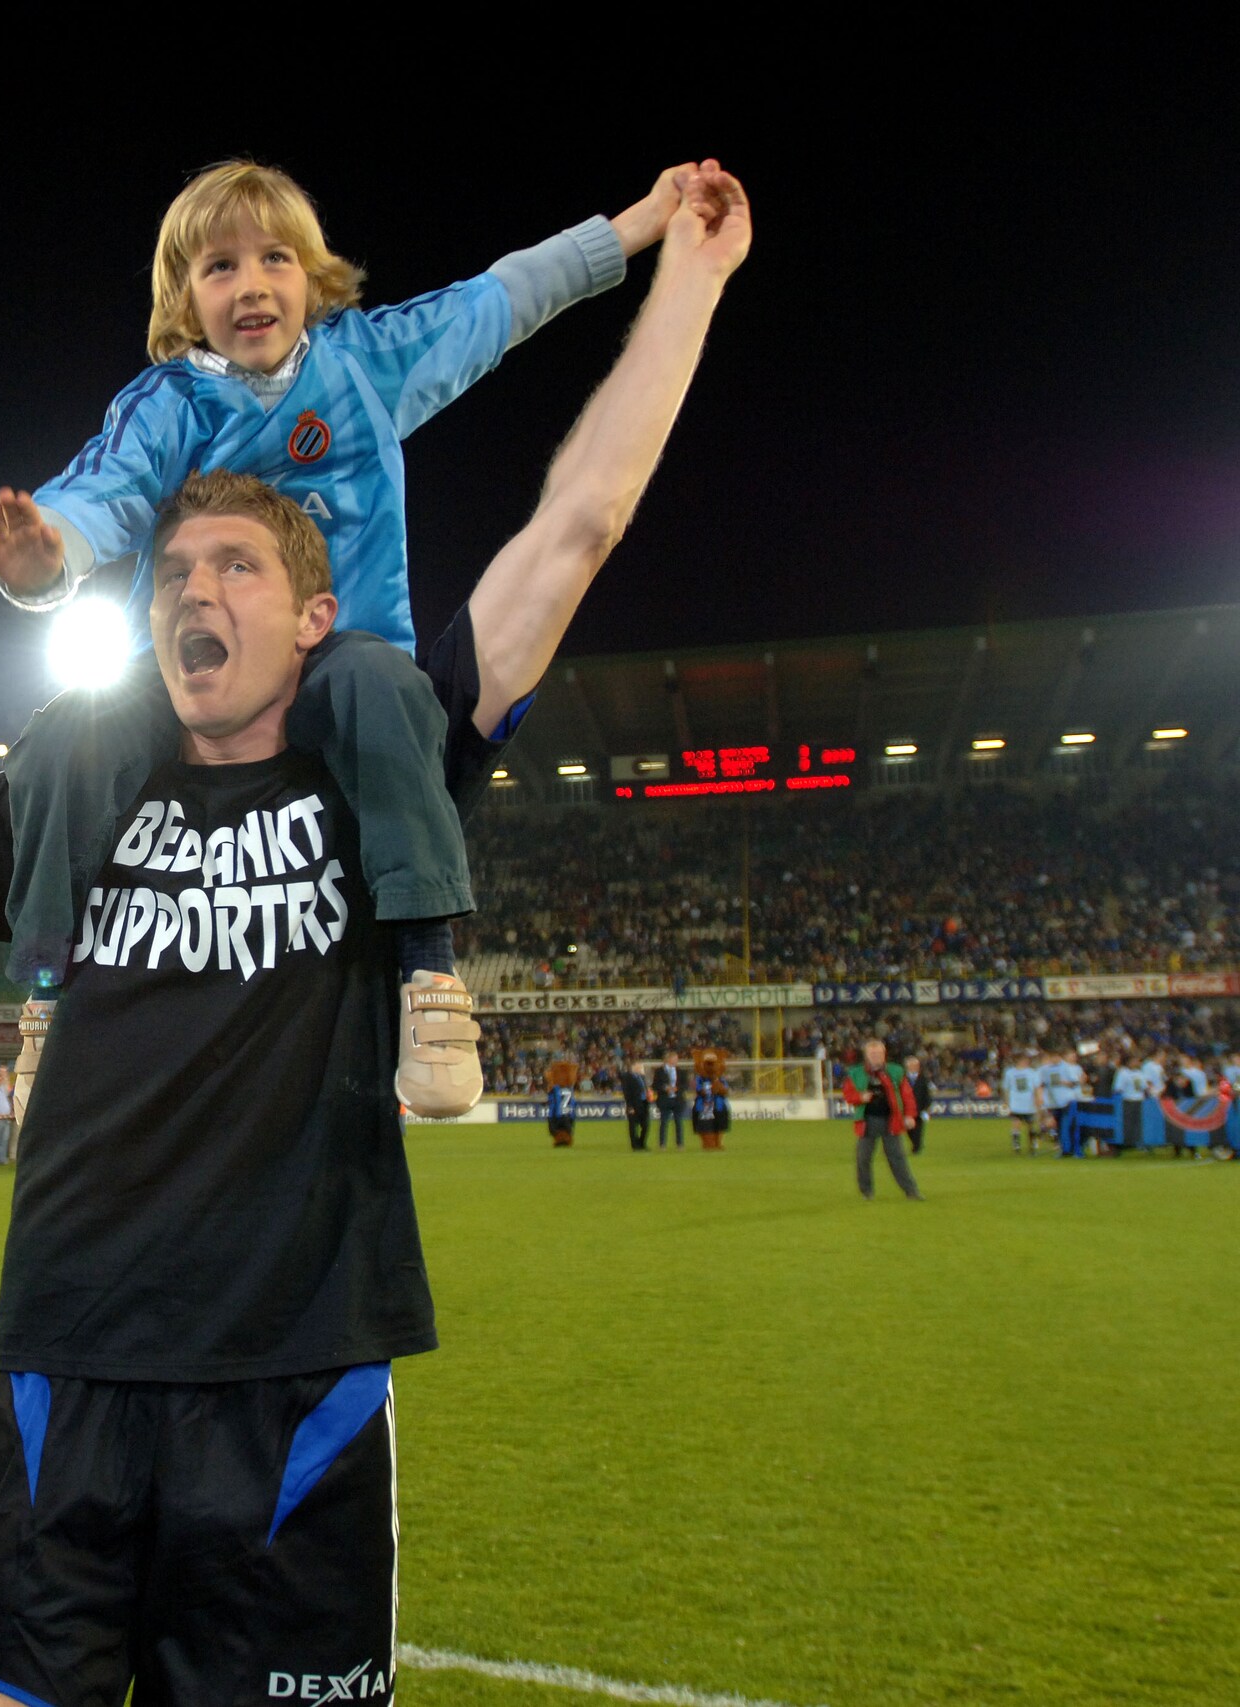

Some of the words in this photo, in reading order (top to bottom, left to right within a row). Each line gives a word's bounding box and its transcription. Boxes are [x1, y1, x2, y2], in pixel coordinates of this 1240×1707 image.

[112, 794, 324, 888] BEDANKT
[815, 983, 912, 1004] DEXIA
[940, 978, 1042, 1000] DEXIA
[561, 1091, 572, 1109] 7
[505, 1105, 536, 1118] Het
[267, 1658, 387, 1707] DEXIA
